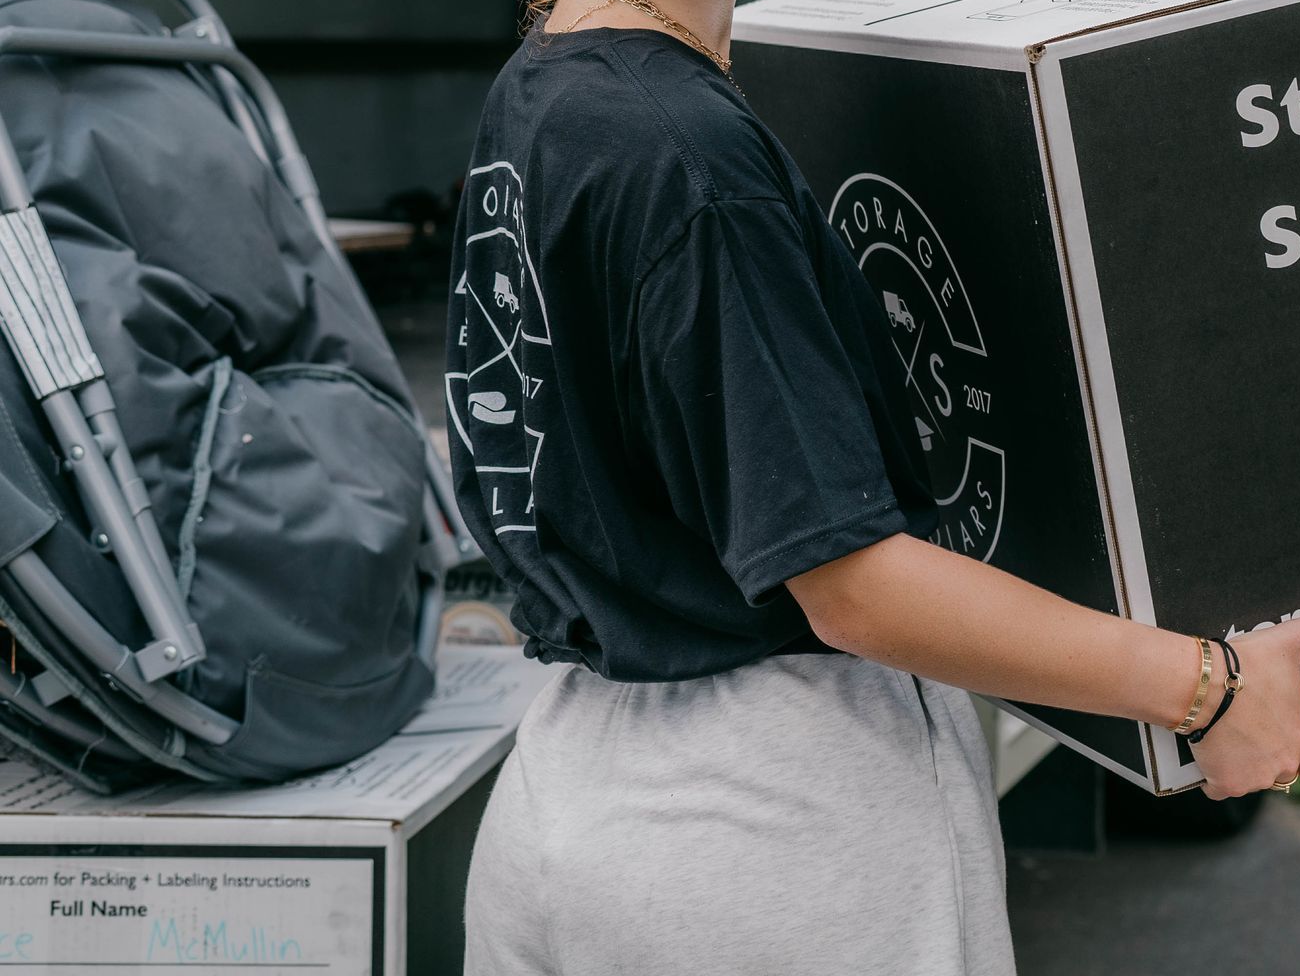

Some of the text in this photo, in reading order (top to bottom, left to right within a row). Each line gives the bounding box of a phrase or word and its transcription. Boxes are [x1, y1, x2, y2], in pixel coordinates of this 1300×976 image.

[840, 196, 955, 308] TORAGE
[930, 353, 952, 417] S
[963, 384, 992, 415] 2017
[54, 872, 75, 886] for
[81, 872, 137, 891] Packing
[158, 873, 218, 891] Labeling
[222, 873, 311, 887] Instructions
[50, 900, 148, 917] Full Name
[147, 917, 303, 963] McMullin
